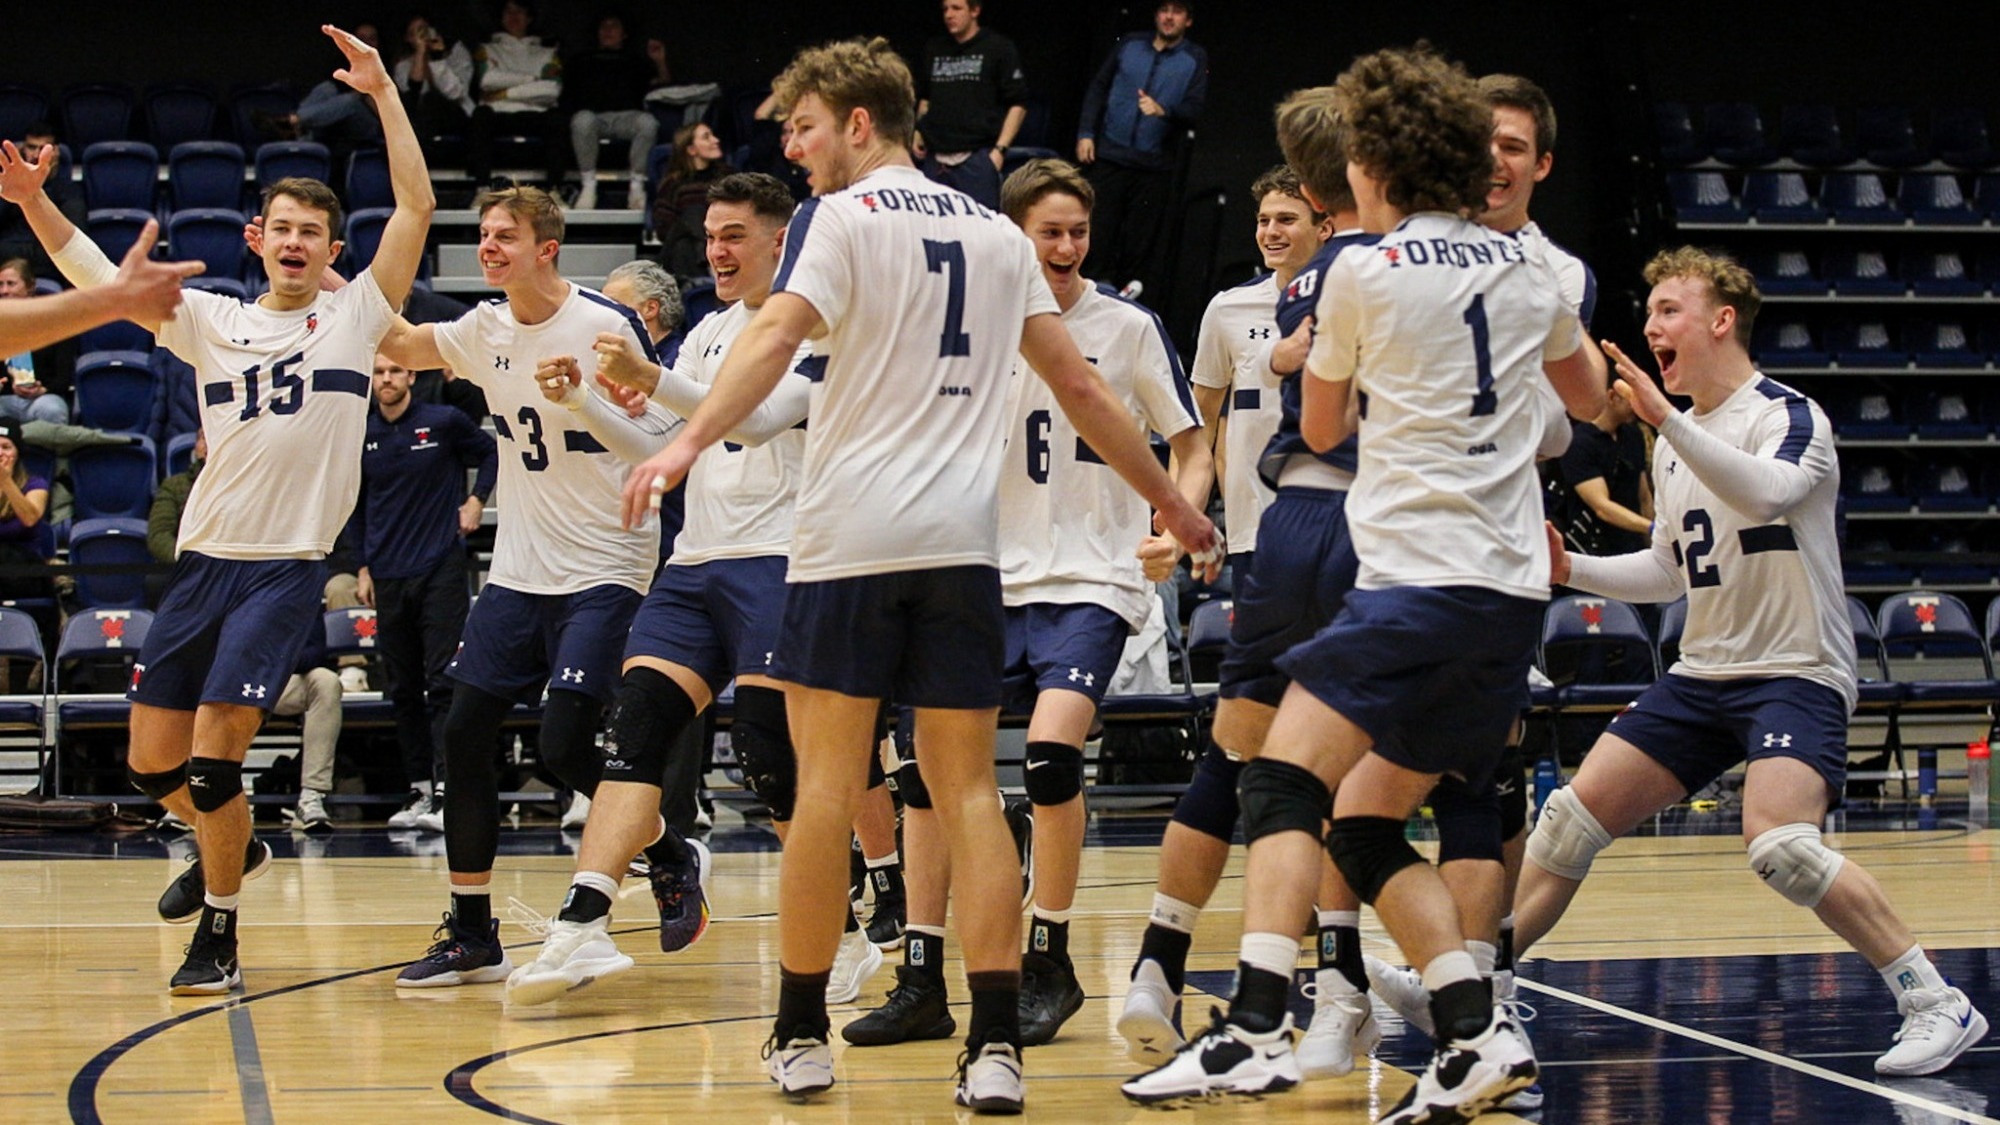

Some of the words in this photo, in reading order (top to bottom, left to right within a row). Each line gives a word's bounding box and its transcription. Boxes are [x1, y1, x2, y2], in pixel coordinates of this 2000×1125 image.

[922, 238, 970, 358] 7
[240, 351, 304, 421] 15
[1464, 293, 1498, 417] 1
[517, 406, 549, 471] 3
[1026, 409, 1052, 484] 6
[1682, 508, 1721, 588] 2
